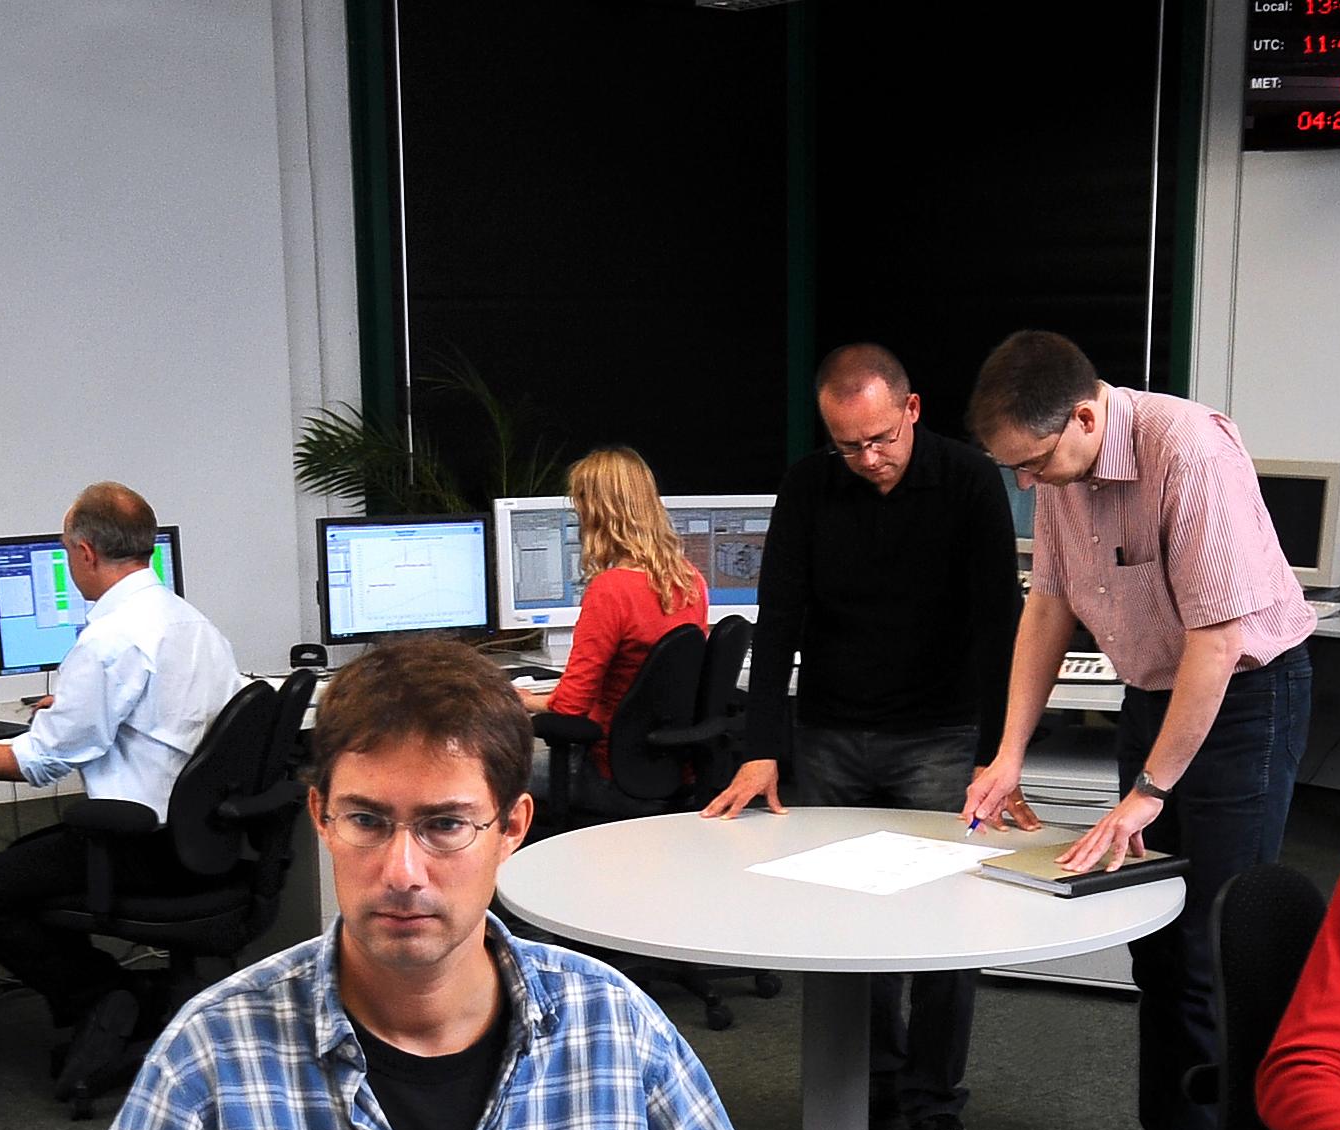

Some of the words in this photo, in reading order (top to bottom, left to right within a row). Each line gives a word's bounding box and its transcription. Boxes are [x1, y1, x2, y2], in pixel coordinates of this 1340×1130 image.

[1255, 0, 1292, 13] Local:
[1253, 39, 1285, 51] UTC:
[1250, 76, 1282, 89] MET:
